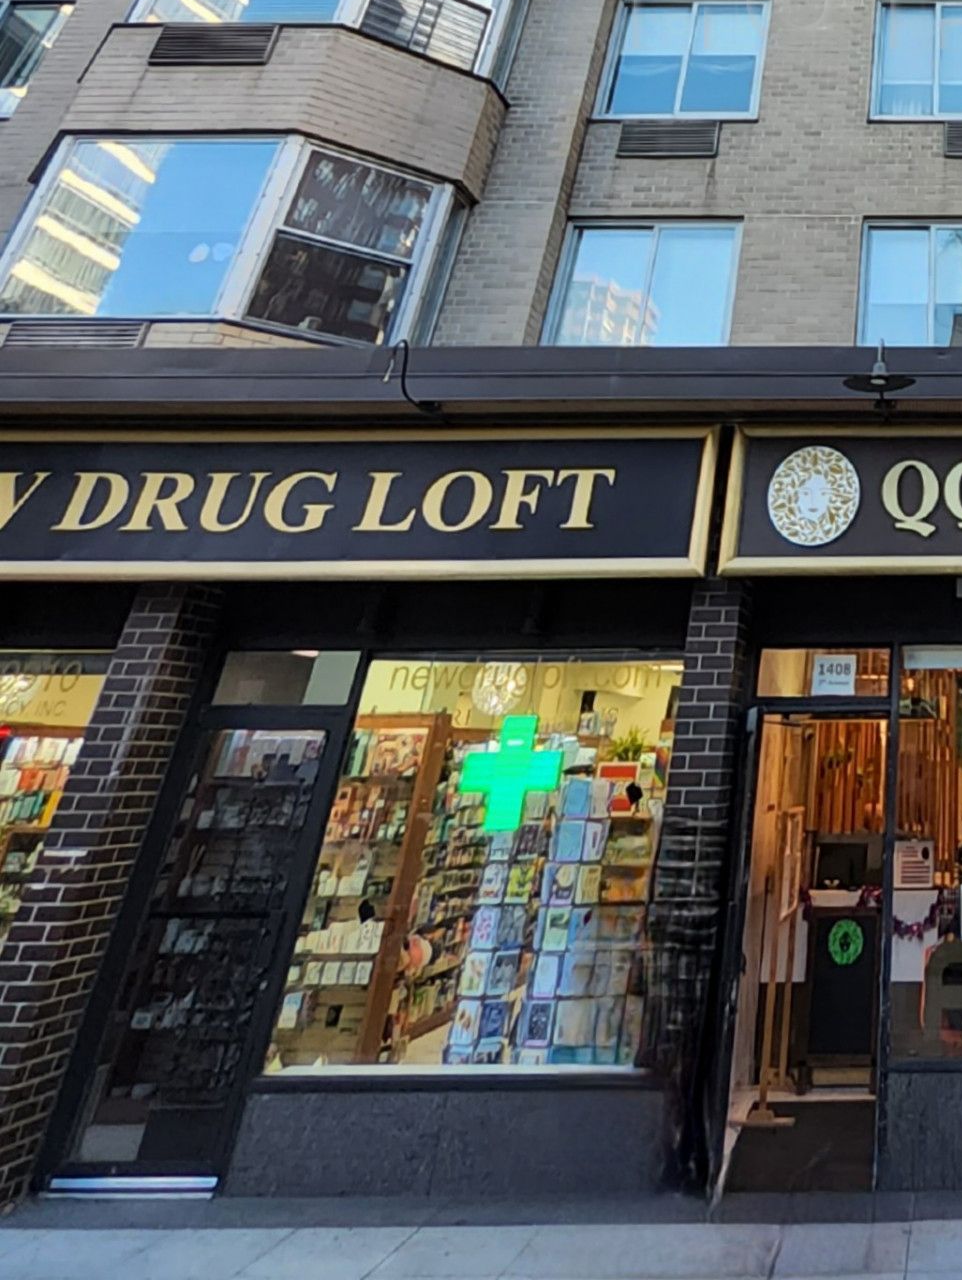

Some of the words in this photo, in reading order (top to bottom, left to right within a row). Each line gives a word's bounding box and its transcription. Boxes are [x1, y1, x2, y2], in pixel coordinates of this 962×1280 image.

[50, 471, 339, 532] DRUG
[352, 468, 615, 532] LOFT
[819, 663, 852, 676] 1408
